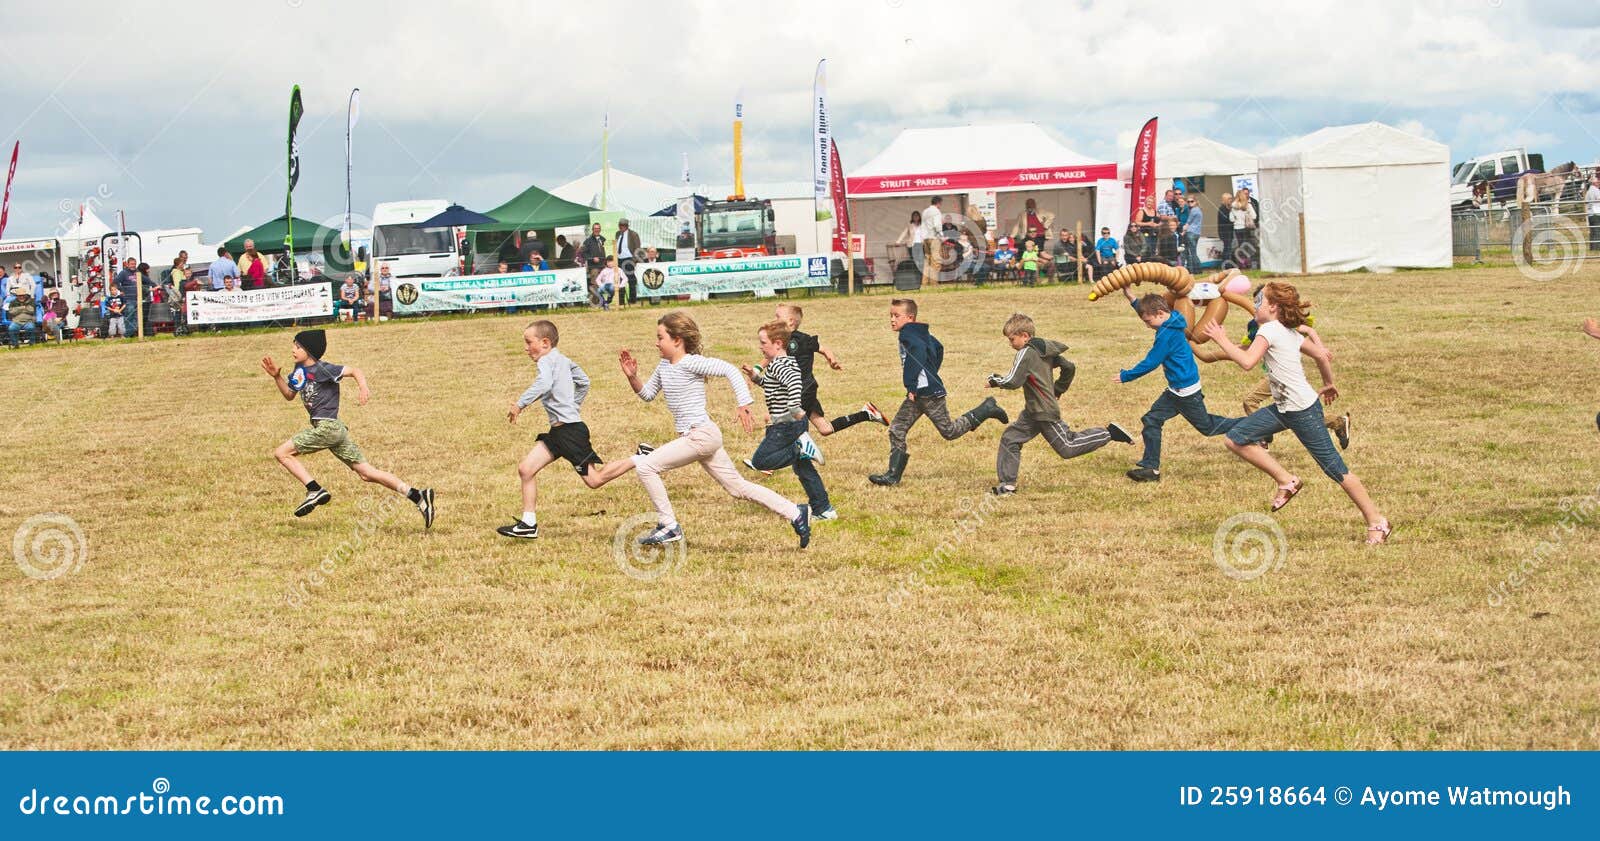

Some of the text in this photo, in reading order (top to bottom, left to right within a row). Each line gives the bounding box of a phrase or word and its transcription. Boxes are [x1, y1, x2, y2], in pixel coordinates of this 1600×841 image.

[1140, 129, 1152, 180] PARKER
[1018, 170, 1086, 181] STRUTT PARKER
[880, 177, 948, 189] STRUTT PARKER
[670, 265, 697, 274] GEORGE
[746, 260, 784, 271] SOLUTIONS
